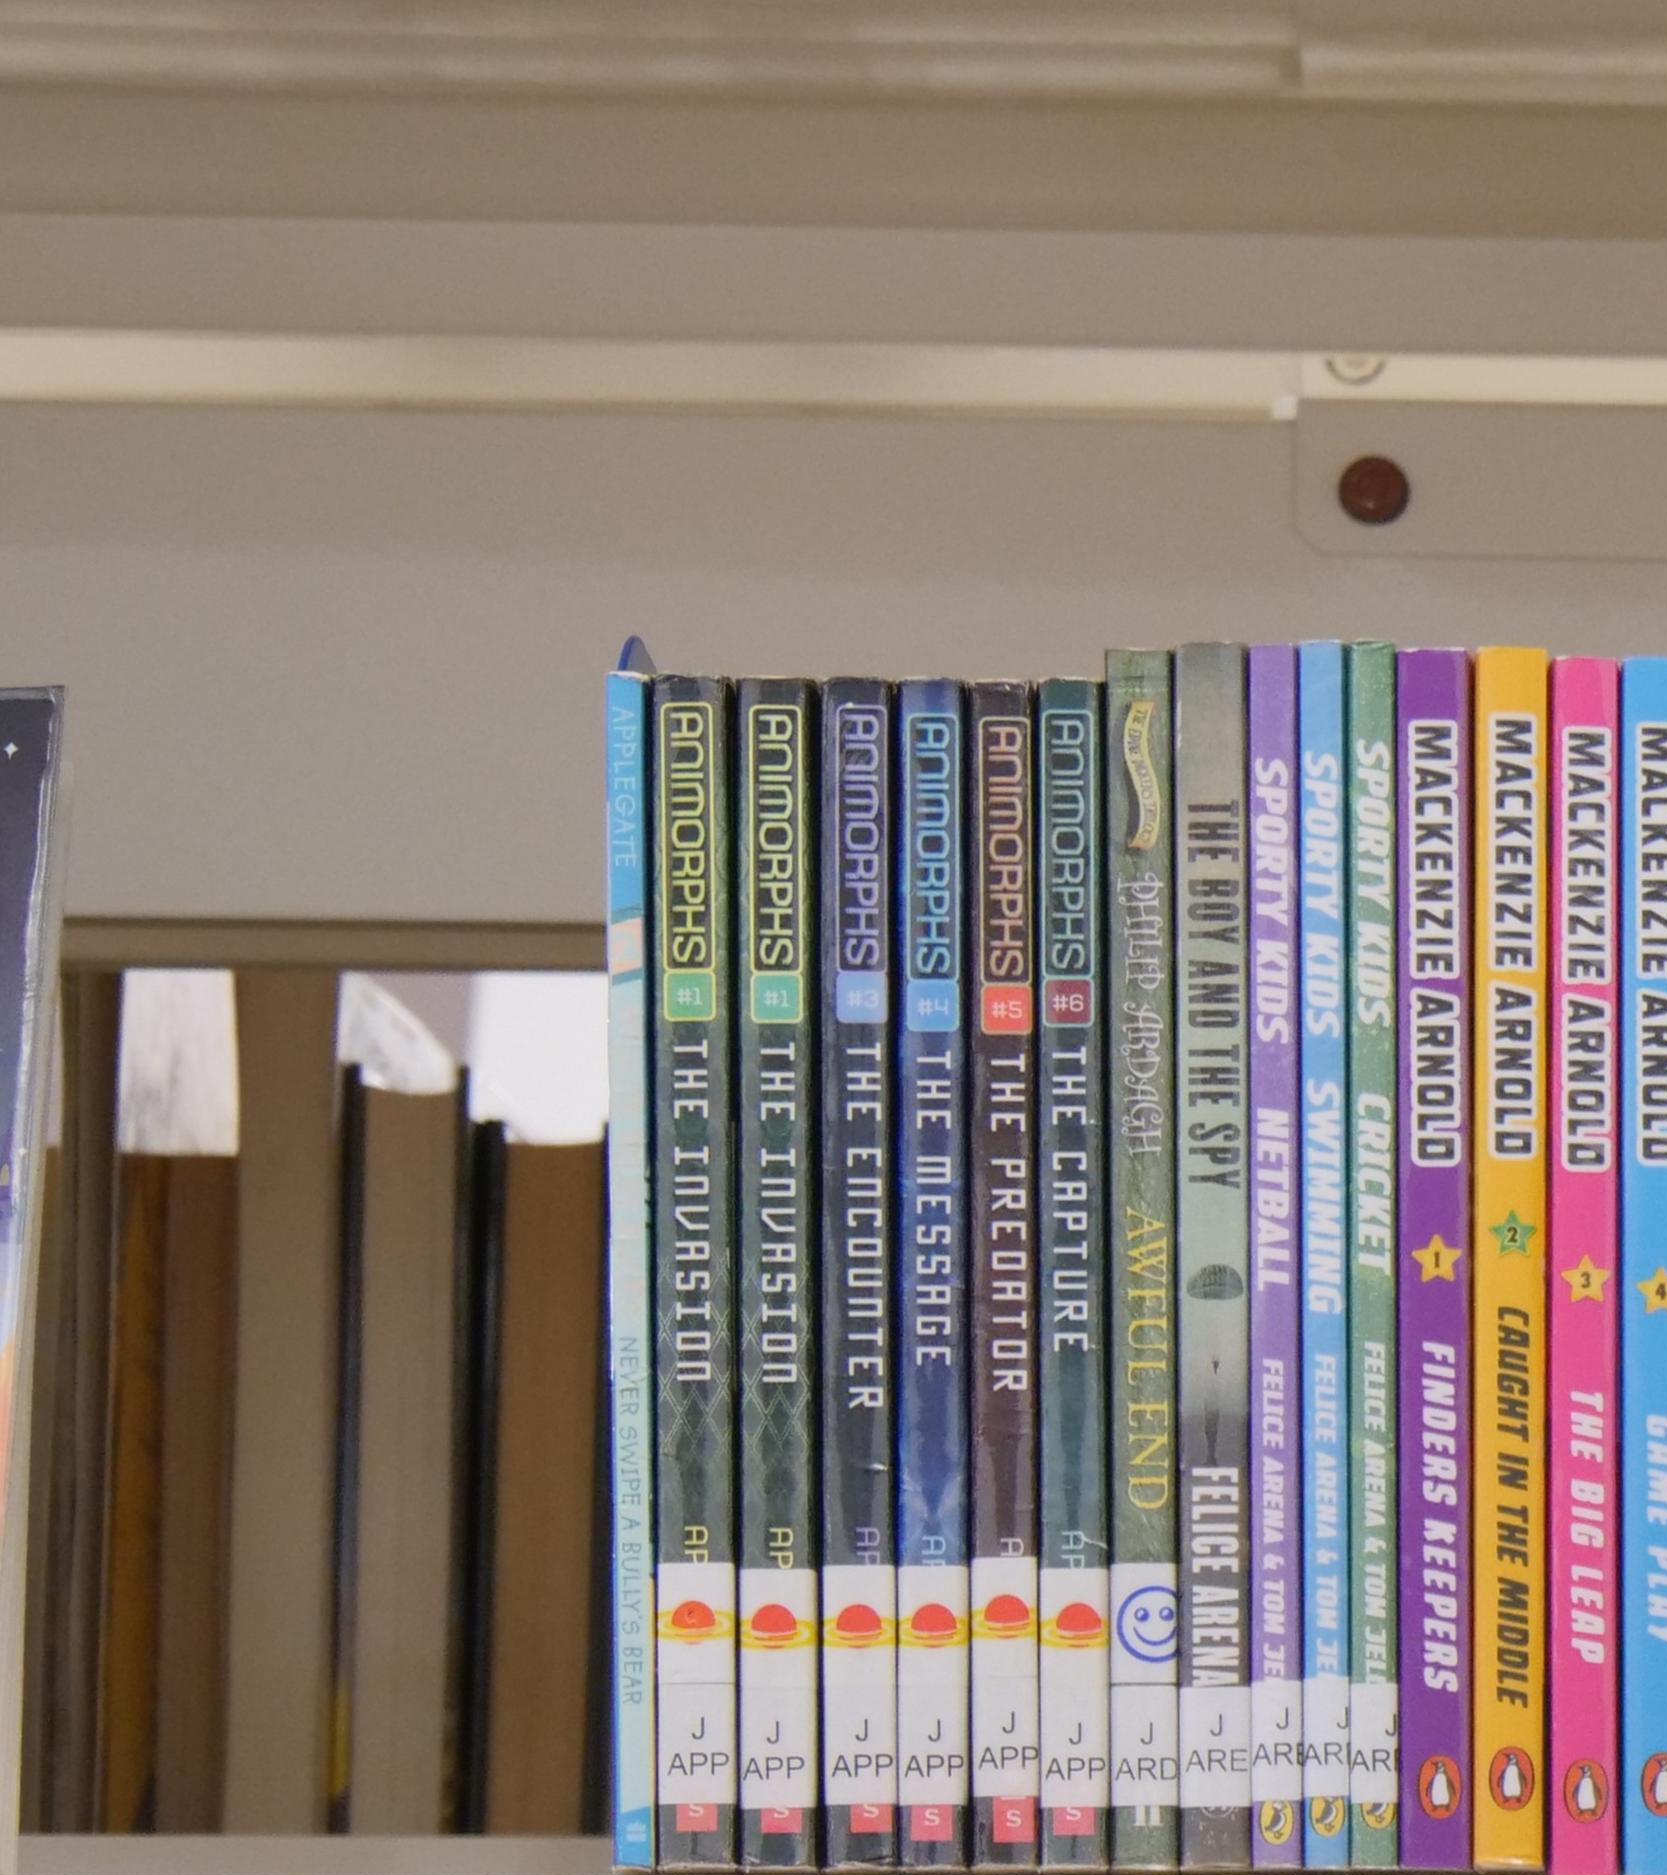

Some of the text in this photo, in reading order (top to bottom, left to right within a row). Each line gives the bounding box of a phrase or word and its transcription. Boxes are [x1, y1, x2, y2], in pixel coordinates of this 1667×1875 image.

[610, 704, 637, 869] APPLEGATE
[670, 710, 706, 966] ANIMORPHS
[757, 711, 794, 966] ANIMORPHS
[845, 711, 881, 967] ANIMORPHS
[916, 719, 951, 975] ANIMORPHS
[988, 725, 1025, 978] ANIMORPHS
[1051, 719, 1086, 972] ANIMORPHS
[1254, 756, 1290, 1045] SPORTY KIDS
[1304, 751, 1341, 1039] SPORTY KIDS
[1355, 738, 1392, 1028] SPORTY KIDS
[990, 1001, 1024, 1020] #5
[1052, 993, 1085, 1013] #6
[1187, 800, 1240, 1189] THE BOY AND THE SPY
[1413, 724, 1456, 1162] MACKENZIE ARNOLD
[1494, 718, 1533, 1155] MACKENZIE ARNOLD
[1567, 731, 1608, 1169] MACKENZIE ARNOLD
[673, 1039, 711, 1383] THE INVASION
[916, 1050, 951, 1367] THE MESSAGE
[1052, 1046, 1090, 1353] THE CAPTURE
[1121, 1001, 1164, 1159] ARDAGH
[1256, 1109, 1291, 1292] NETBALL
[1307, 1080, 1343, 1315] SWIMMING
[1356, 1093, 1393, 1277] CRICKET
[760, 1043, 797, 1384] THE INVASION
[846, 1043, 884, 1409] THE ENCOUNTER
[990, 1053, 1027, 1392] THE PREDATOR
[1432, 1251, 1442, 1269] 1
[1506, 1226, 1519, 1243] 2
[1579, 1271, 1592, 1288] 3
[1654, 1282, 1667, 1300] 4
[1125, 1207, 1170, 1511] AWFUL END
[618, 1336, 644, 1706] NEVER SWIPE A BULLY'S BEAR
[1191, 1466, 1240, 1688] FELICE ARENA
[1422, 1341, 1459, 1693] FINDERS KEEPERS
[1496, 1306, 1530, 1709] CAUGHT IN THE MIDDLE
[1569, 1391, 1606, 1665] THE BIG LEAP
